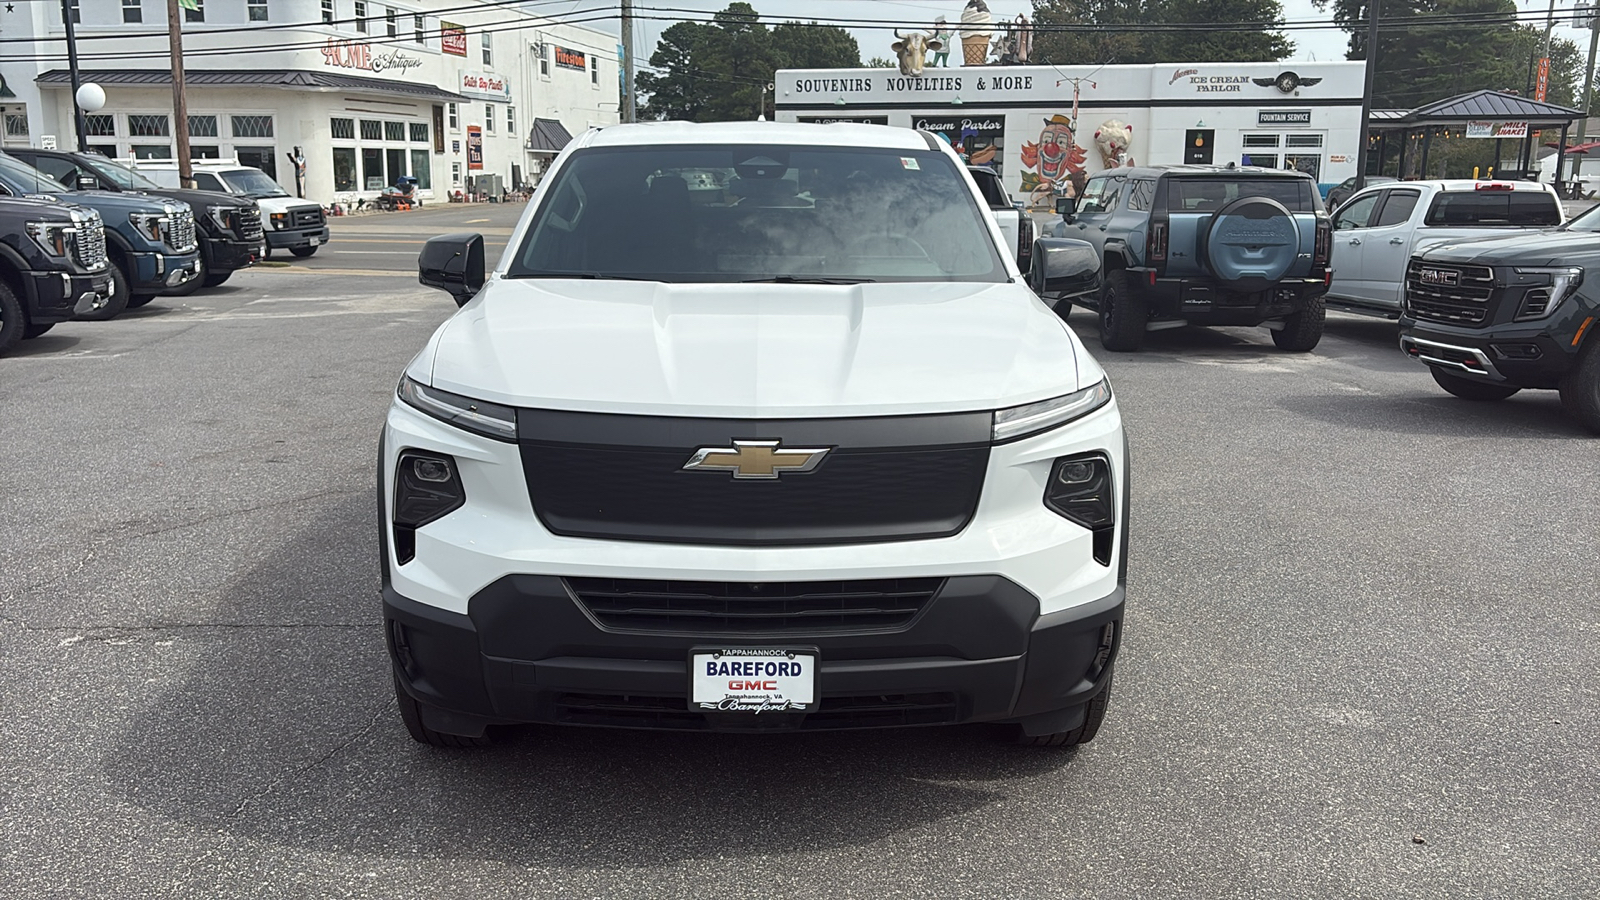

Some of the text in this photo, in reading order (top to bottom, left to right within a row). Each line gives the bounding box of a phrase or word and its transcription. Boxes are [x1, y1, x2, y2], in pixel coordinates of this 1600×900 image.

[321, 37, 423, 75] ACME Antiques
[464, 75, 503, 92] Dutch Boy Paints
[795, 76, 1033, 93] SOUVENIRS NOVELTIES & MORE
[1190, 76, 1250, 84] ICE CREAM
[1260, 113, 1309, 121] FOUNTAIN SERVICE
[916, 118, 1002, 131] Cream Parlor
[1503, 121, 1527, 129] MILK
[1421, 269, 1458, 285] GMC
[722, 649, 787, 657] TAPPAHANNOCK
[706, 661, 802, 677] BAREFORD
[728, 680, 778, 691] GMC
[717, 699, 791, 715] Bareford
